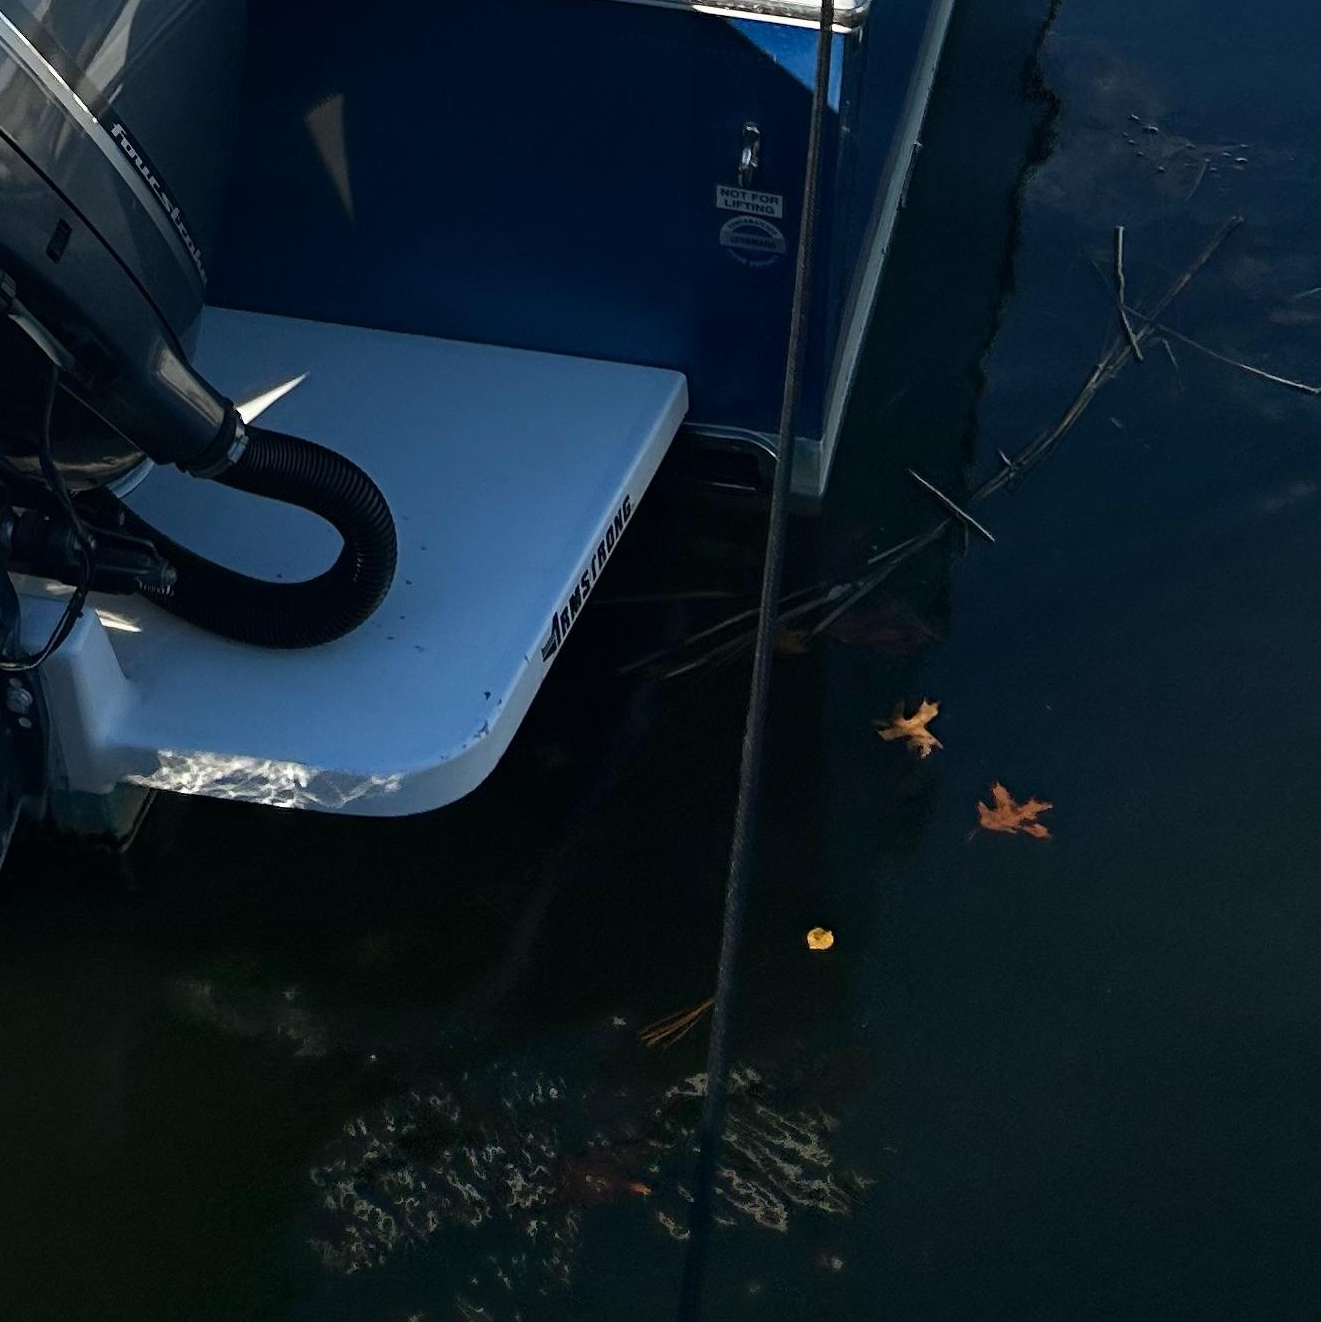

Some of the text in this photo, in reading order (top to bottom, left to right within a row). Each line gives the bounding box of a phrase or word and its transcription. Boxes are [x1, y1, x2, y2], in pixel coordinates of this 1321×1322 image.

[720, 188, 779, 205] NOT FOR
[724, 199, 775, 215] LIFTING
[542, 494, 634, 662] ARMSTRONG
